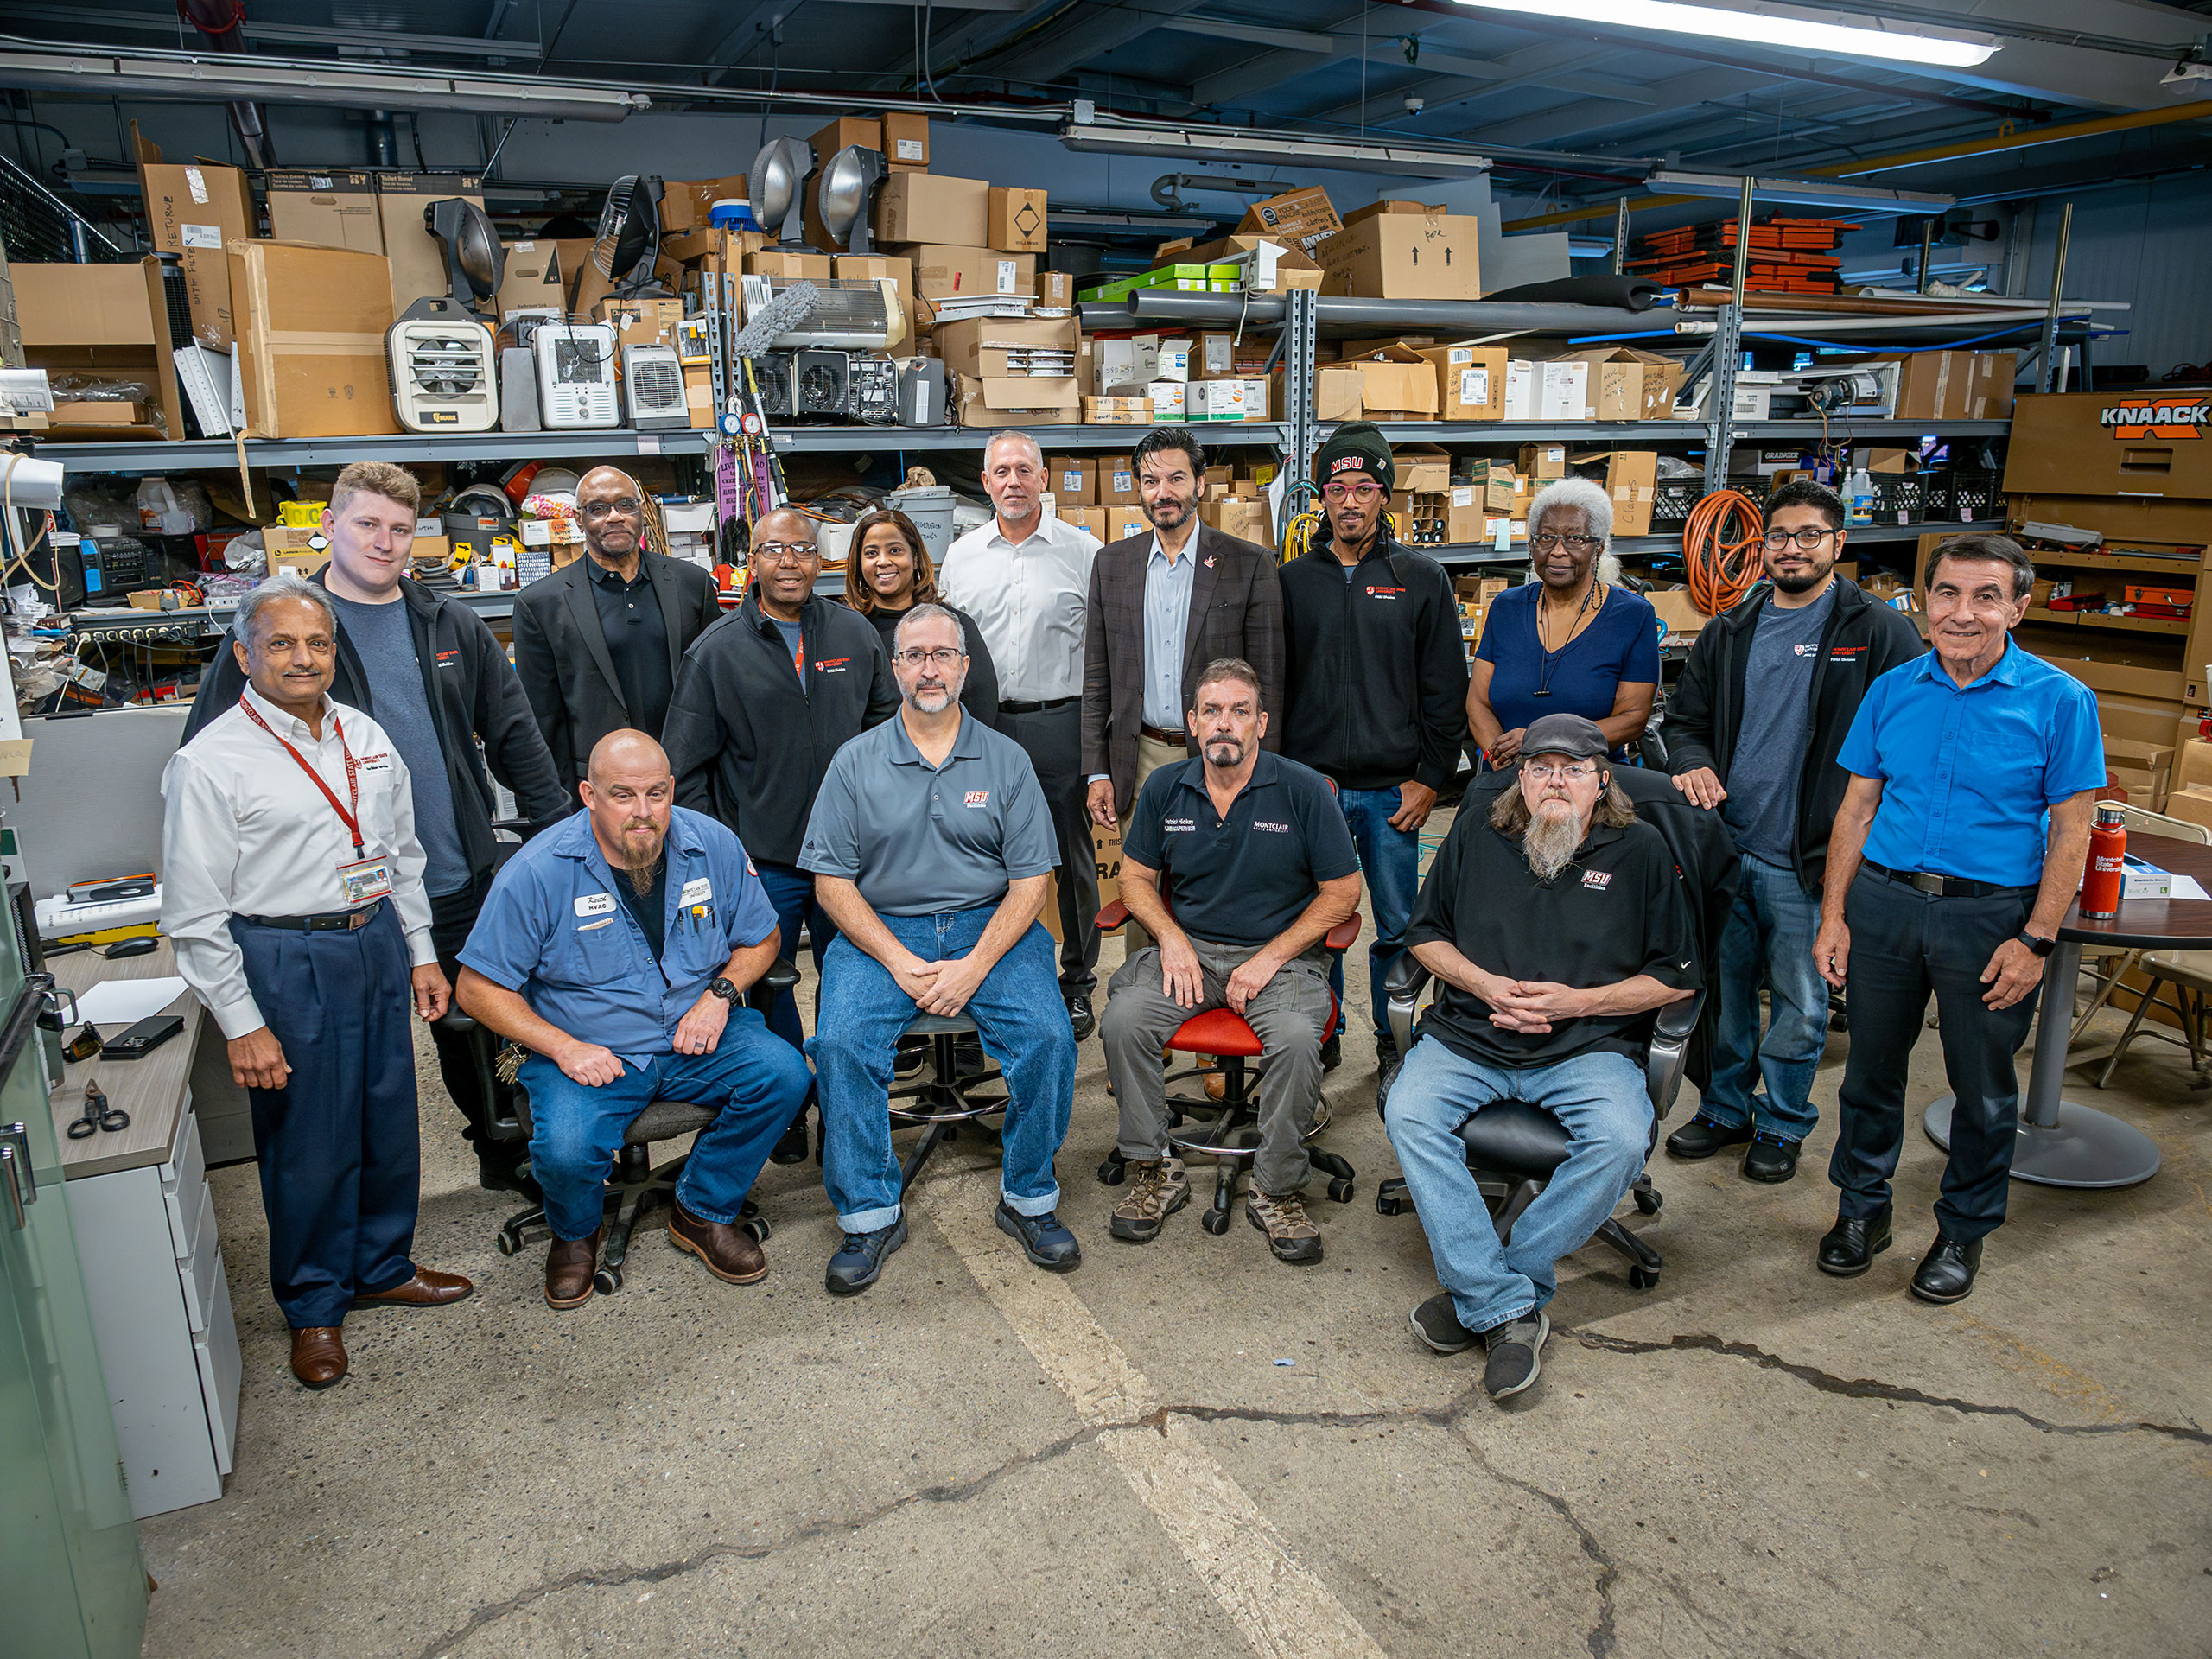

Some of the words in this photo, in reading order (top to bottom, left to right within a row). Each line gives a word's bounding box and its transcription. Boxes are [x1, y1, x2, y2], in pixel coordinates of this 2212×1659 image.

[191, 278, 201, 304] WITH
[2101, 406, 2210, 425] KNAACK
[1332, 456, 1363, 474] MSU
[1622, 479, 1638, 524] Clamps
[964, 791, 989, 804] MSU
[1254, 821, 1288, 830] MONTCLAIR
[1582, 869, 1611, 885] MSU
[587, 895, 607, 905] Keith
